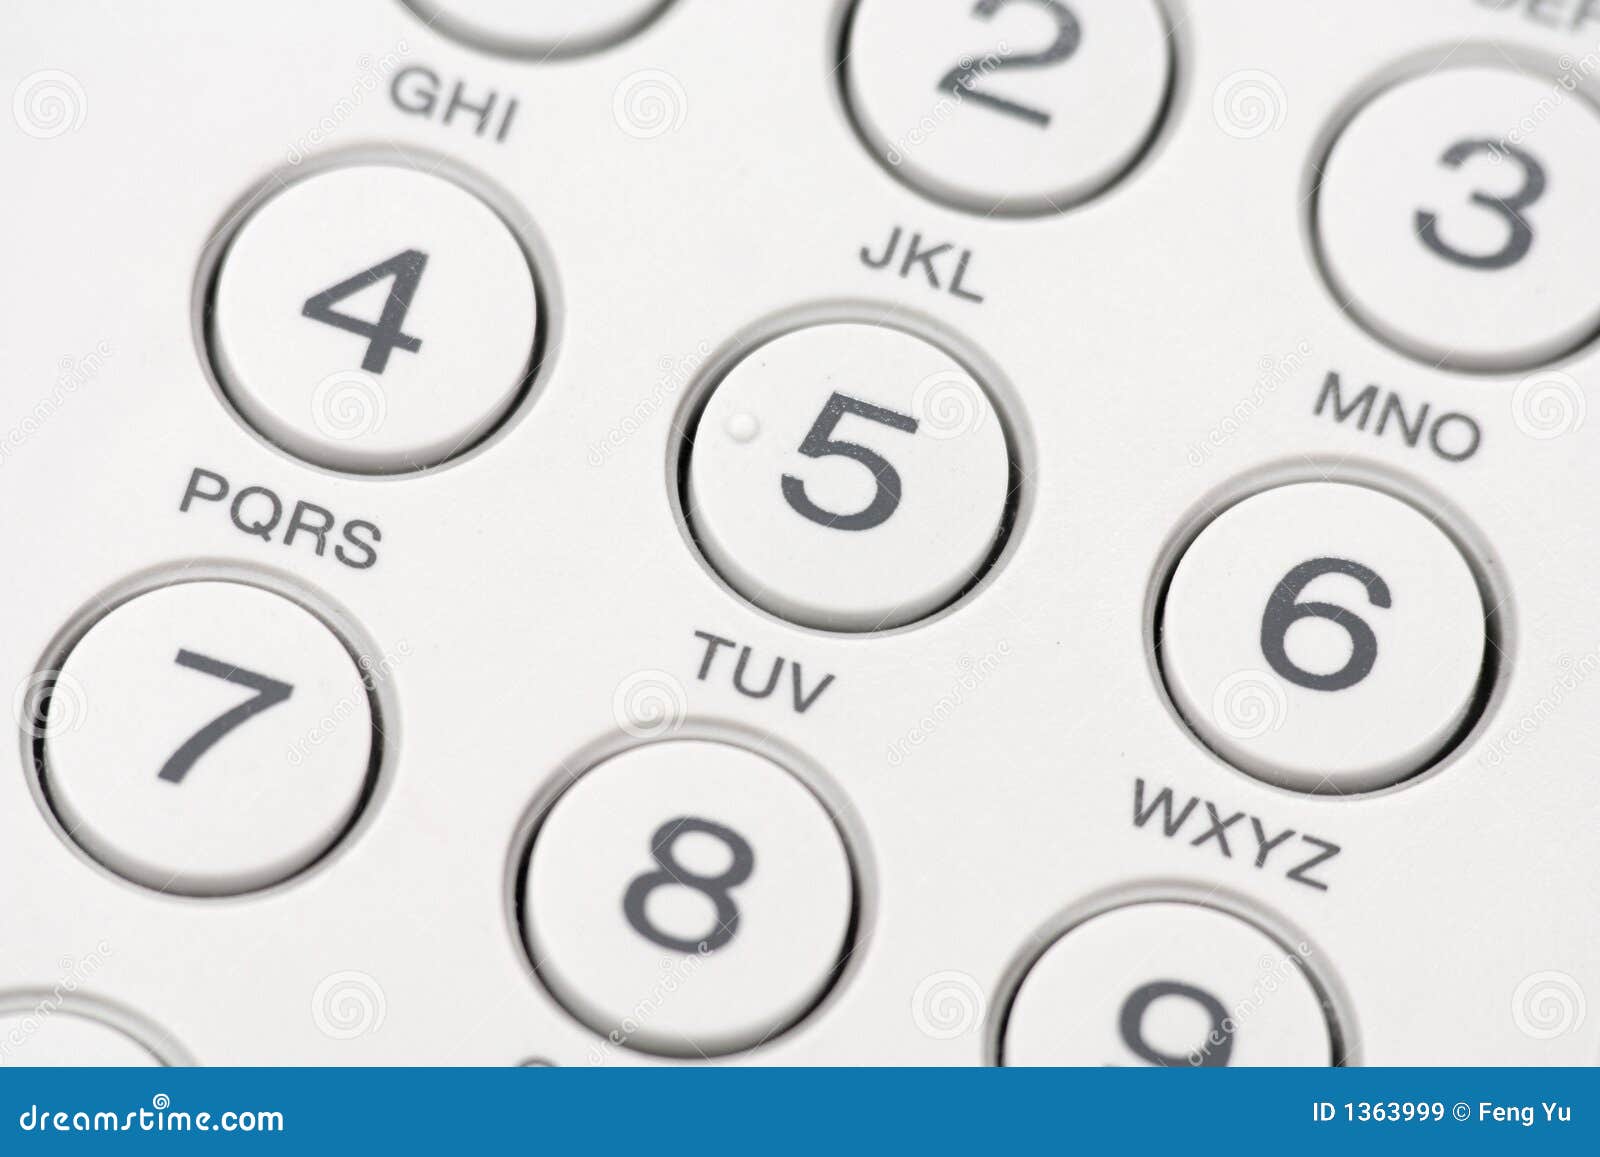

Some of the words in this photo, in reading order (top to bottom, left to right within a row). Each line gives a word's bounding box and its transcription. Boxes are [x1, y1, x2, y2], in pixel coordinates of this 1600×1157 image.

[389, 66, 518, 142] GHI
[937, 0, 1081, 128] 2
[859, 227, 985, 304] JKL
[1414, 138, 1547, 271] 3
[301, 248, 429, 375] 4
[780, 391, 920, 532] 5
[1314, 371, 1482, 464] MNO
[179, 468, 382, 570] PQRS
[694, 629, 836, 715] TUV
[1259, 556, 1393, 693] 6
[157, 648, 295, 785] 7
[621, 815, 756, 956] 8
[1133, 778, 1342, 893] WXYZ
